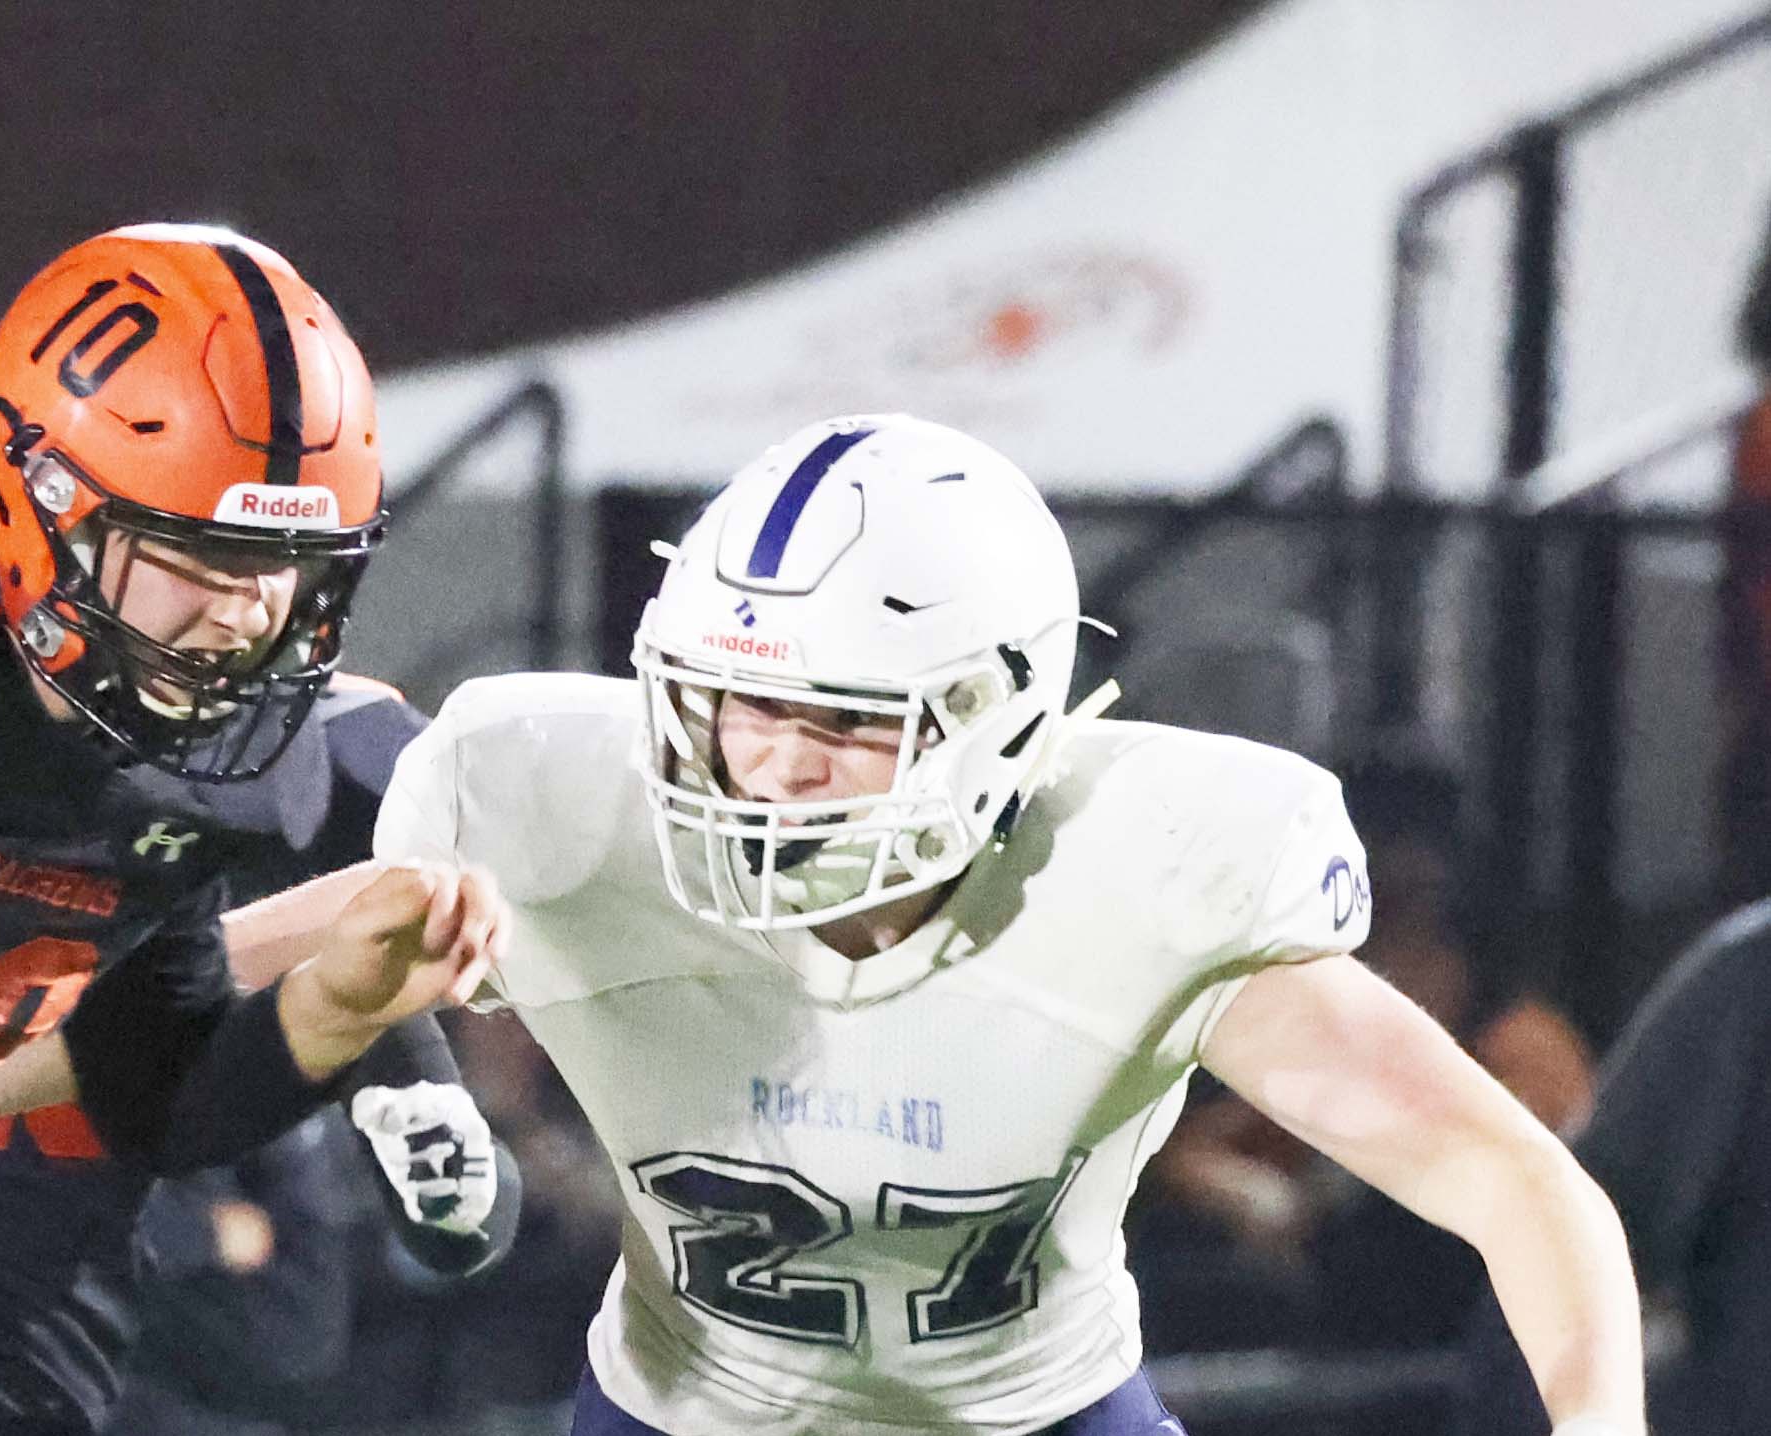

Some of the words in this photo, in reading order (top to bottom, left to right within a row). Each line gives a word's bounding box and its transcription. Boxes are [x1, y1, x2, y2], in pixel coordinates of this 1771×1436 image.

[30, 279, 160, 399] 10
[240, 492, 330, 518] Riddell
[1321, 855, 1371, 932] Do
[750, 1075, 946, 1153] ROCKLAND
[630, 1146, 1091, 1350] 27
